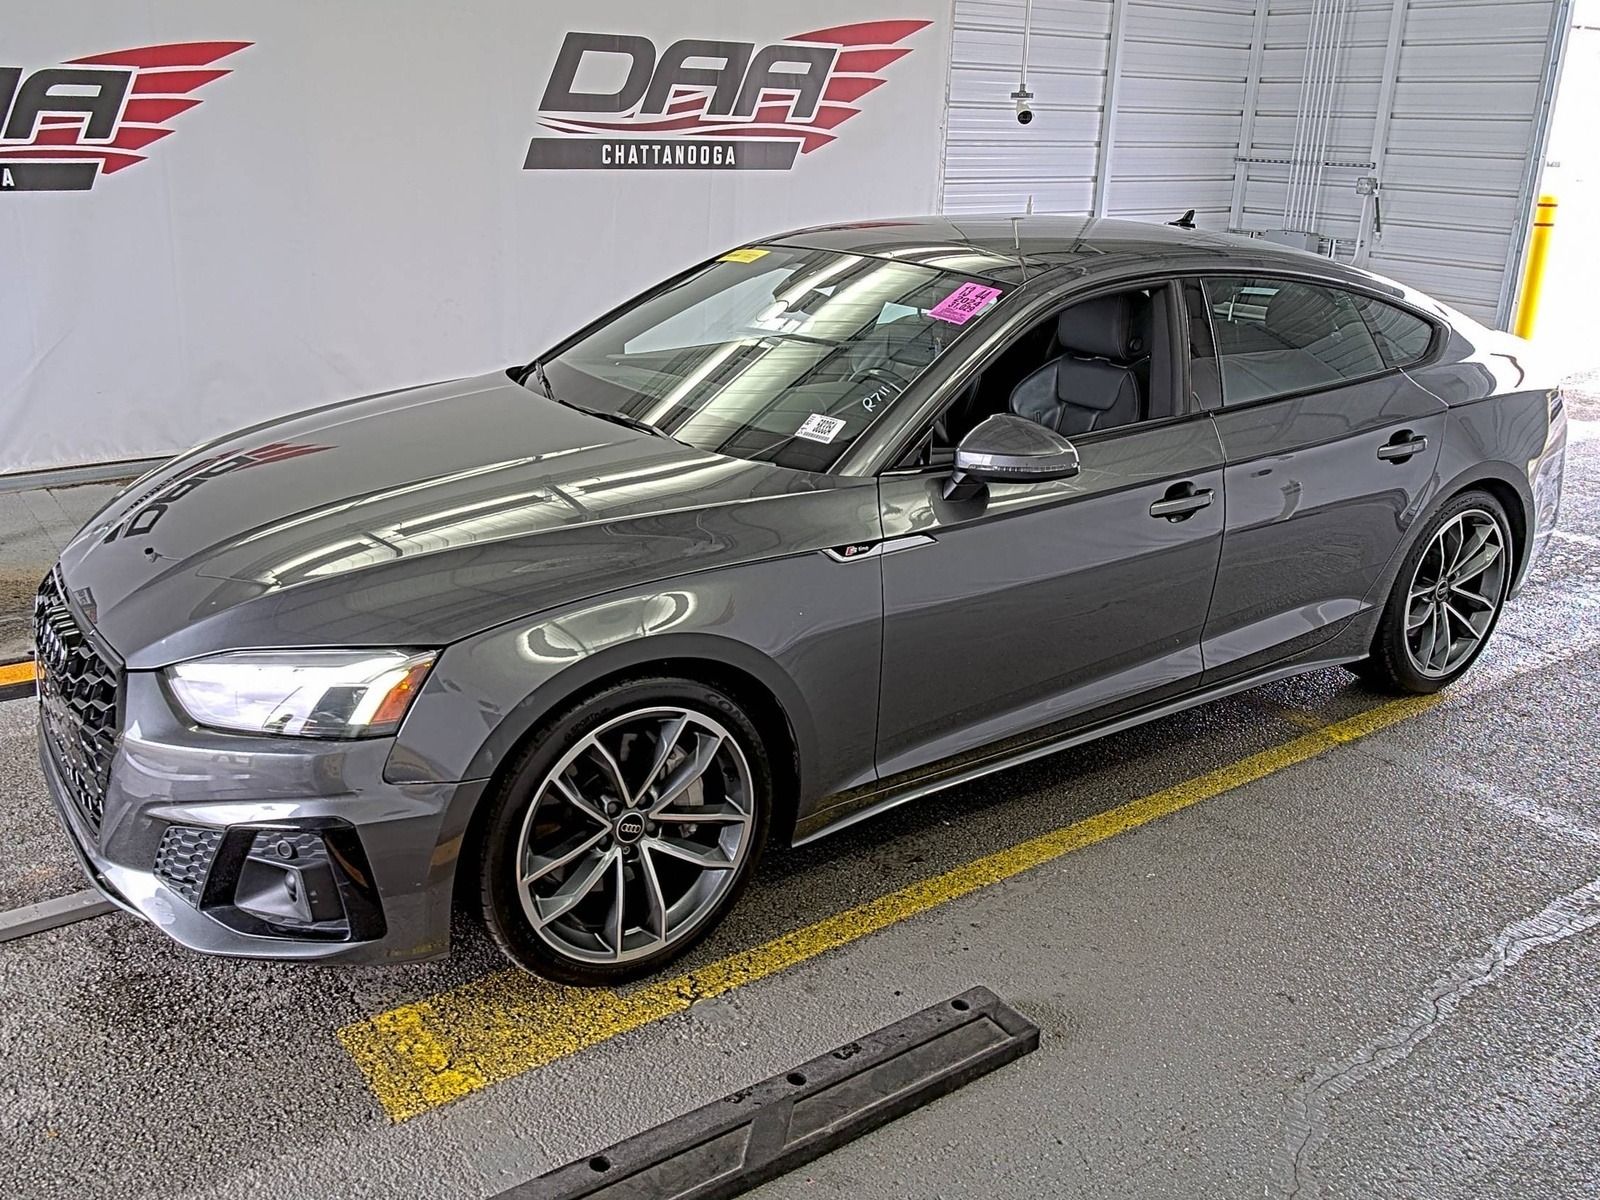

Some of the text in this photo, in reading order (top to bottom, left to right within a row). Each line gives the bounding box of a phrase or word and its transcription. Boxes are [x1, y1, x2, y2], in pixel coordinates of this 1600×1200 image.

[538, 31, 838, 118] DAA
[601, 144, 737, 166] CHATTANOOGA
[953, 295, 982, 308] 2024
[959, 286, 976, 297] 13
[975, 289, 992, 300] 44
